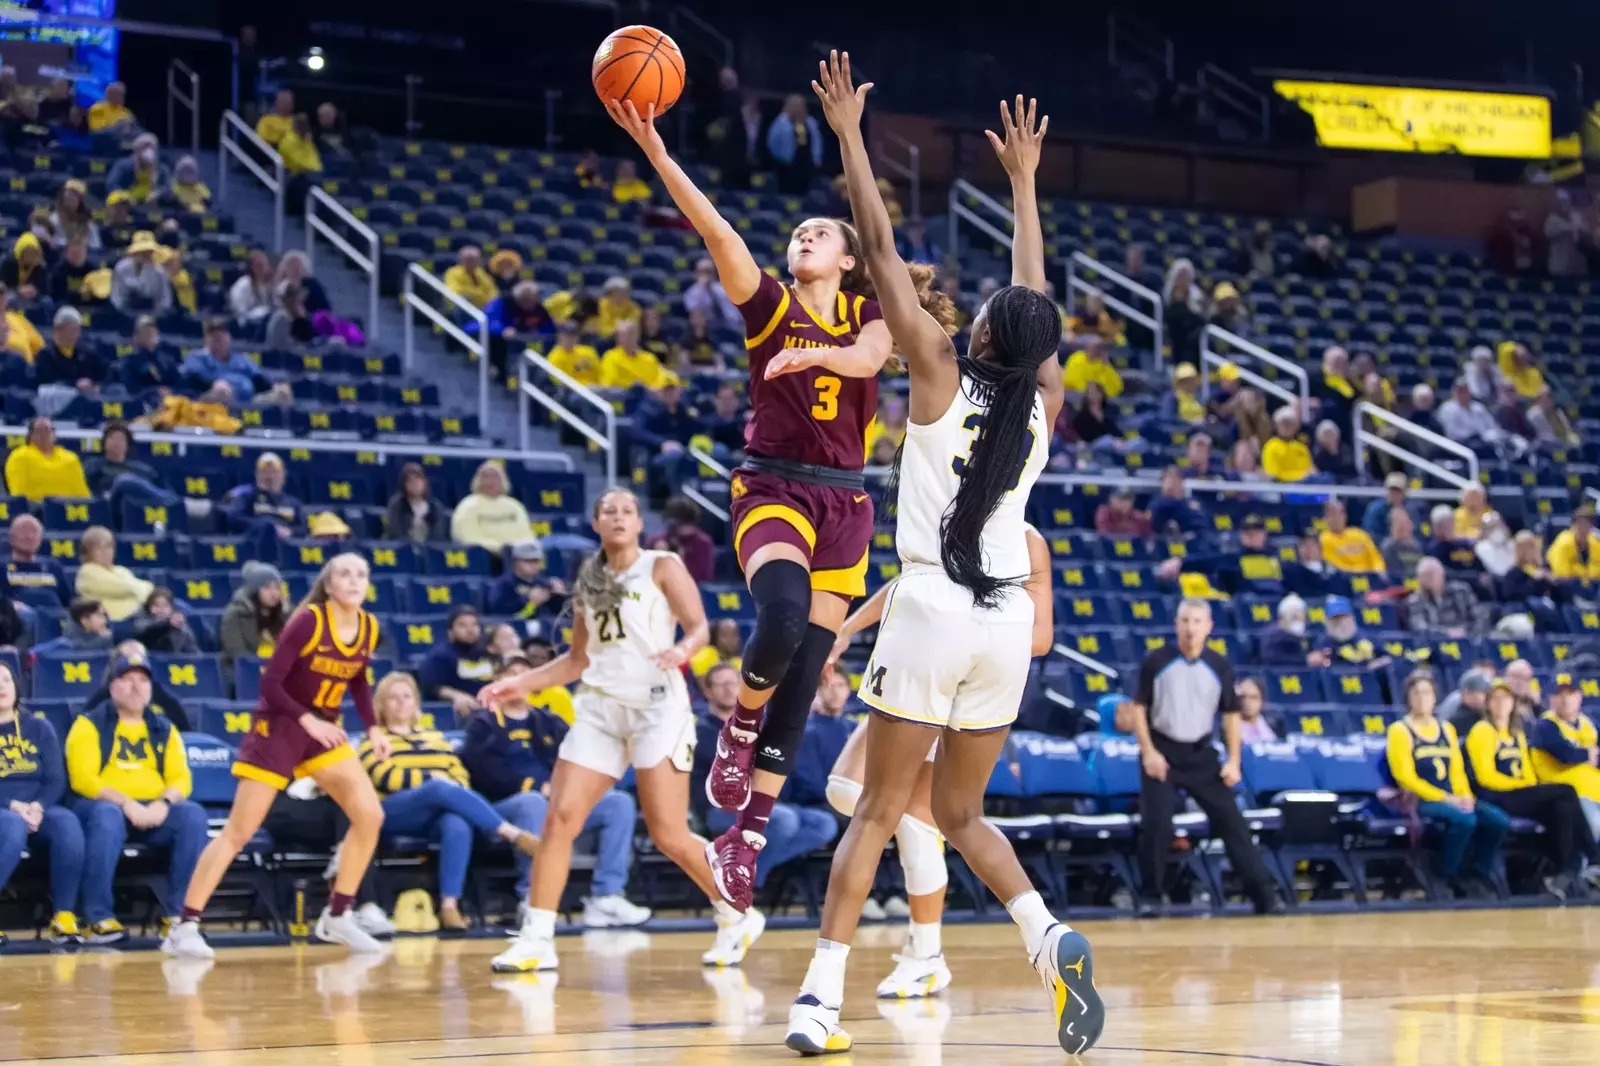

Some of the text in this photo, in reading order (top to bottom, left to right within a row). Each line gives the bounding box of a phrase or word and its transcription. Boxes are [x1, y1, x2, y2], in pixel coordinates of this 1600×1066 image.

[812, 376, 841, 420] 3
[104, 404, 122, 416] M
[187, 479, 207, 492] M
[330, 484, 350, 497] M
[66, 505, 88, 520] M
[145, 508, 167, 523] M
[51, 541, 74, 556] M
[134, 544, 156, 558] M
[214, 546, 235, 560] M
[301, 548, 322, 562] M
[374, 550, 395, 564] M
[447, 552, 466, 566] M
[188, 582, 211, 598] M
[428, 587, 449, 602] M
[719, 594, 739, 608] M
[594, 607, 626, 642] 21
[408, 626, 432, 643] M
[64, 663, 90, 682] M
[170, 665, 196, 684] M
[867, 658, 888, 697] M
[313, 679, 347, 708] 10
[225, 713, 252, 732] M
[117, 736, 148, 760] M
